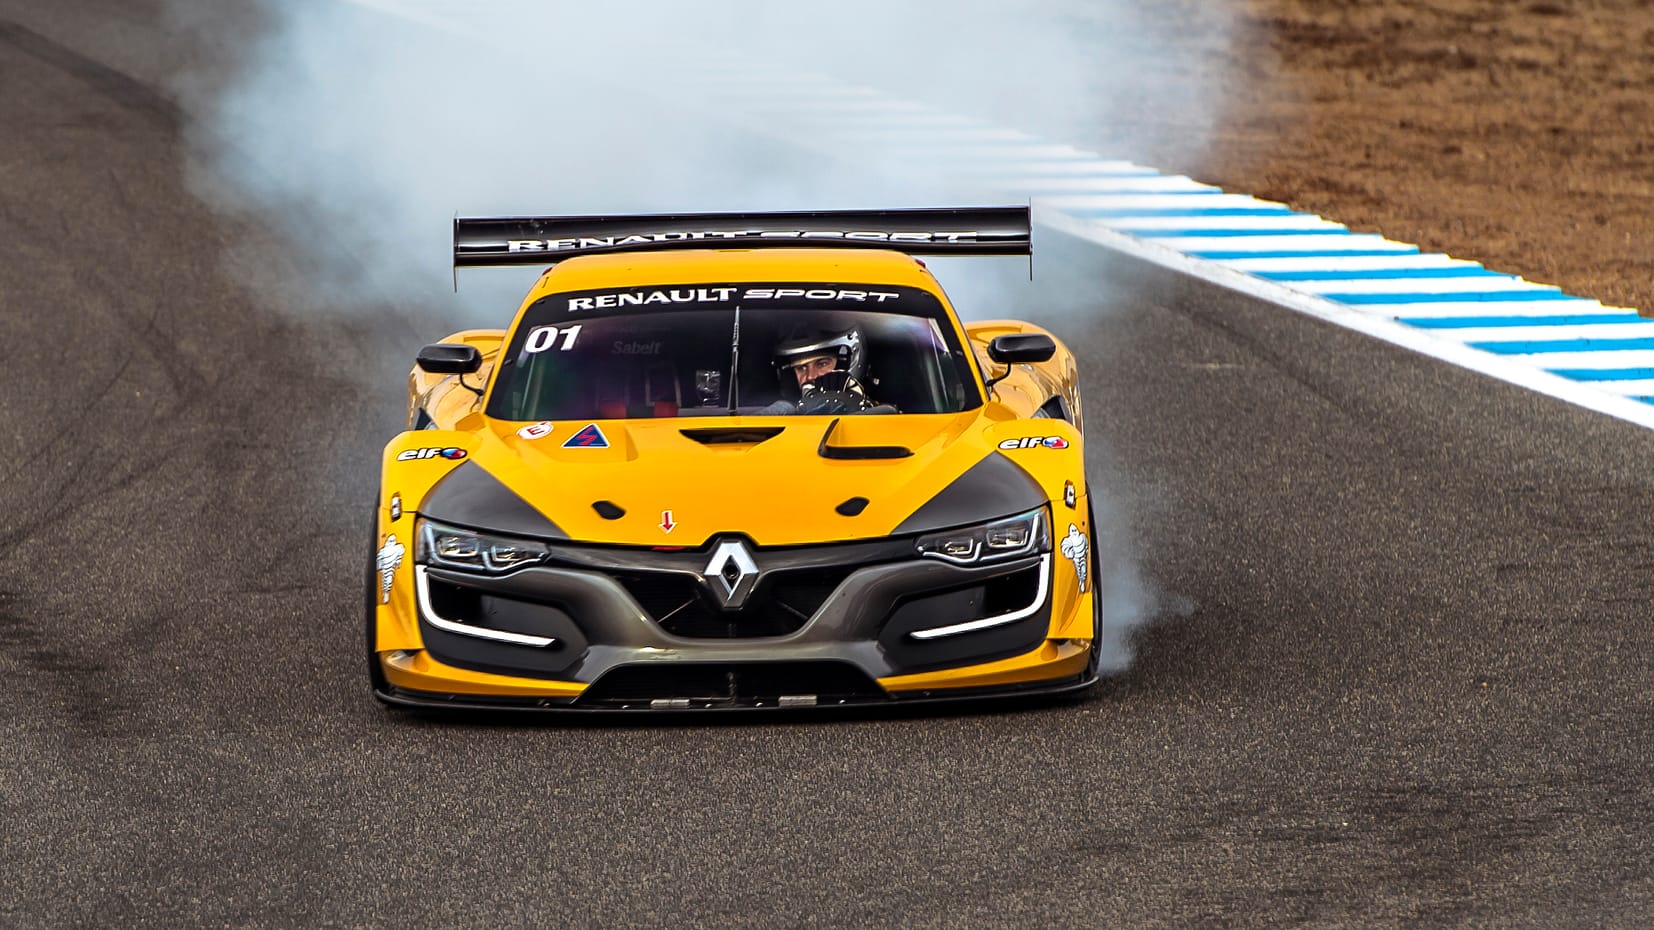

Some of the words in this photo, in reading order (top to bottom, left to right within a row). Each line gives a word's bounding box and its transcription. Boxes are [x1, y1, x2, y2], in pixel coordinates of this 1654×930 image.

[567, 287, 738, 312] RENAULT
[743, 287, 899, 302] SPORT
[524, 324, 583, 354] 01
[611, 340, 662, 355] Sabelt
